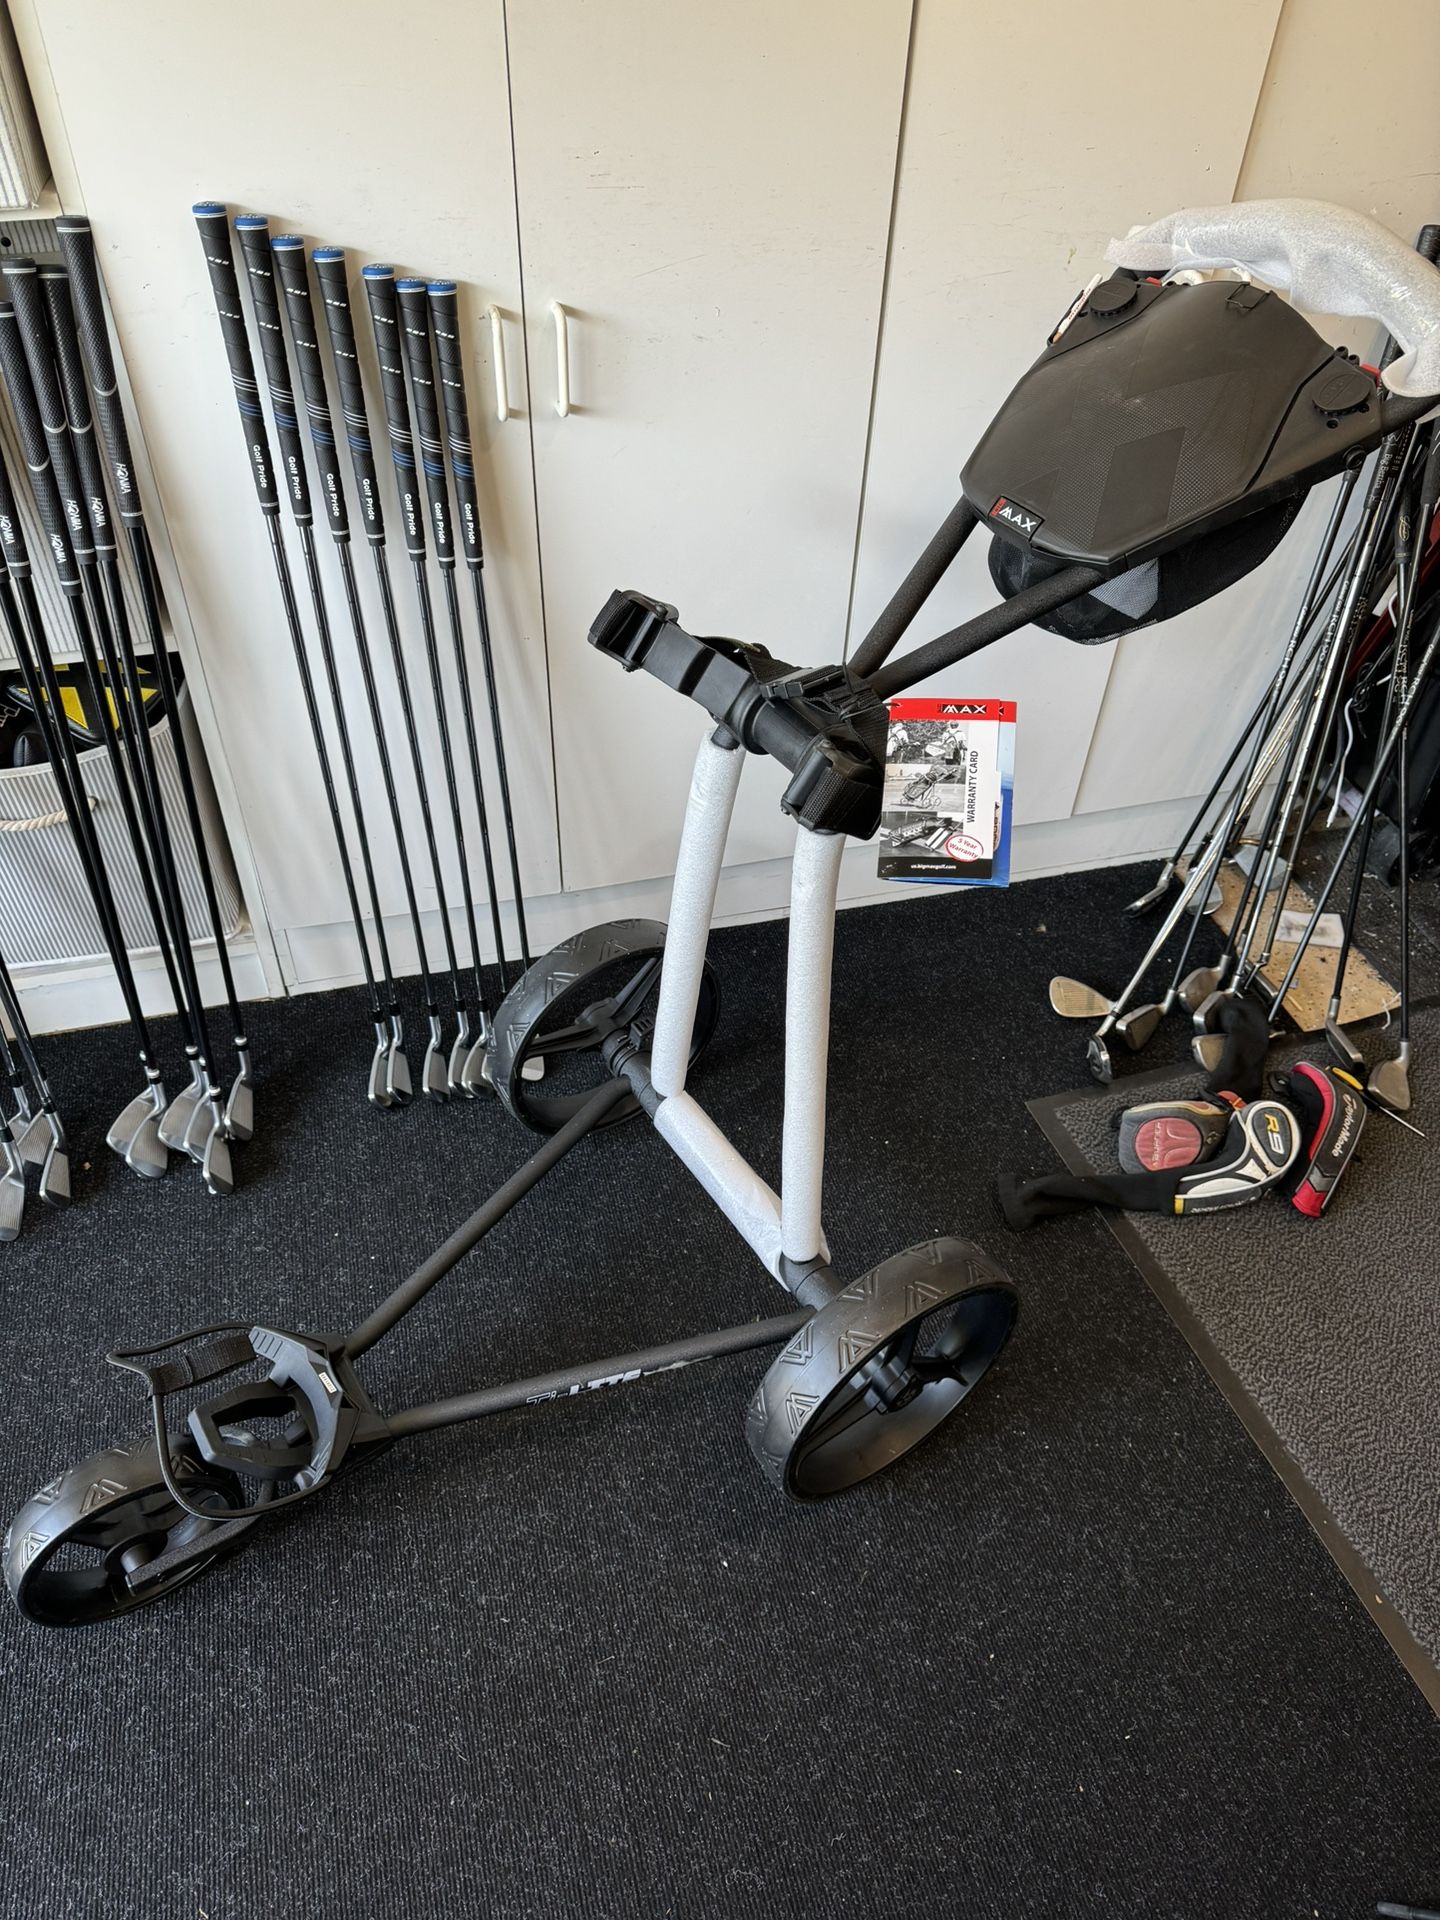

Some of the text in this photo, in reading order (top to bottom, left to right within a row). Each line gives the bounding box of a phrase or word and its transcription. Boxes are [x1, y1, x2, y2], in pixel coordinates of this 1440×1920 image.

[115, 462, 131, 494] HONMA
[252, 444, 268, 488] Golf Pride
[288, 456, 302, 500] Golf Pride
[66, 499, 82, 531] HONMA
[90, 497, 106, 528] HONMA
[326, 473, 340, 517] Golf Pride
[362, 478, 375, 521] Golf Pride
[404, 493, 416, 536] Golf Pride
[434, 502, 446, 544] Golf Pride
[464, 502, 476, 545] Golf Pride
[998, 506, 1037, 532] MAX
[50, 533, 67, 564] HONMA
[943, 704, 986, 714] MAX
[967, 750, 979, 823] WARRANTY CARD
[949, 842, 979, 859] Warranty
[964, 840, 978, 850] Year
[1332, 1093, 1357, 1158] TaylorMade
